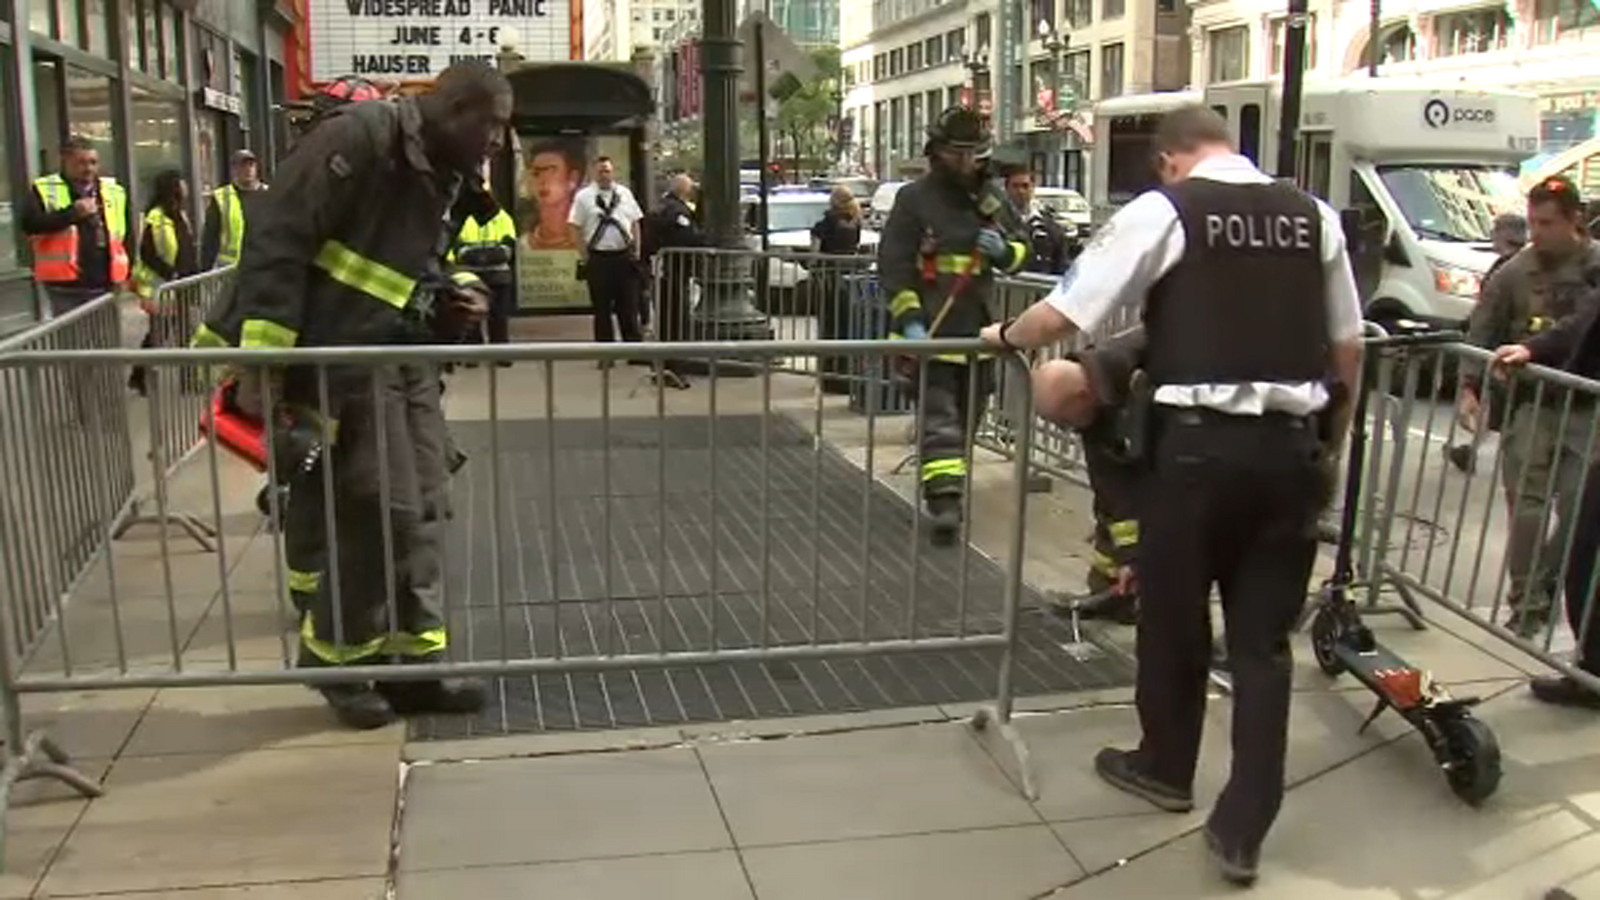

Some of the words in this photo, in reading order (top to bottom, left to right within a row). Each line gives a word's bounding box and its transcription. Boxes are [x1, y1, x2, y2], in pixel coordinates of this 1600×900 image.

[347, 0, 470, 17] WIDESPREAD
[489, 0, 546, 17] PANIC
[391, 26, 441, 45] JUNE
[352, 54, 430, 74] HAUSER
[1453, 107, 1495, 123] pace
[1206, 213, 1310, 248] POLICE
